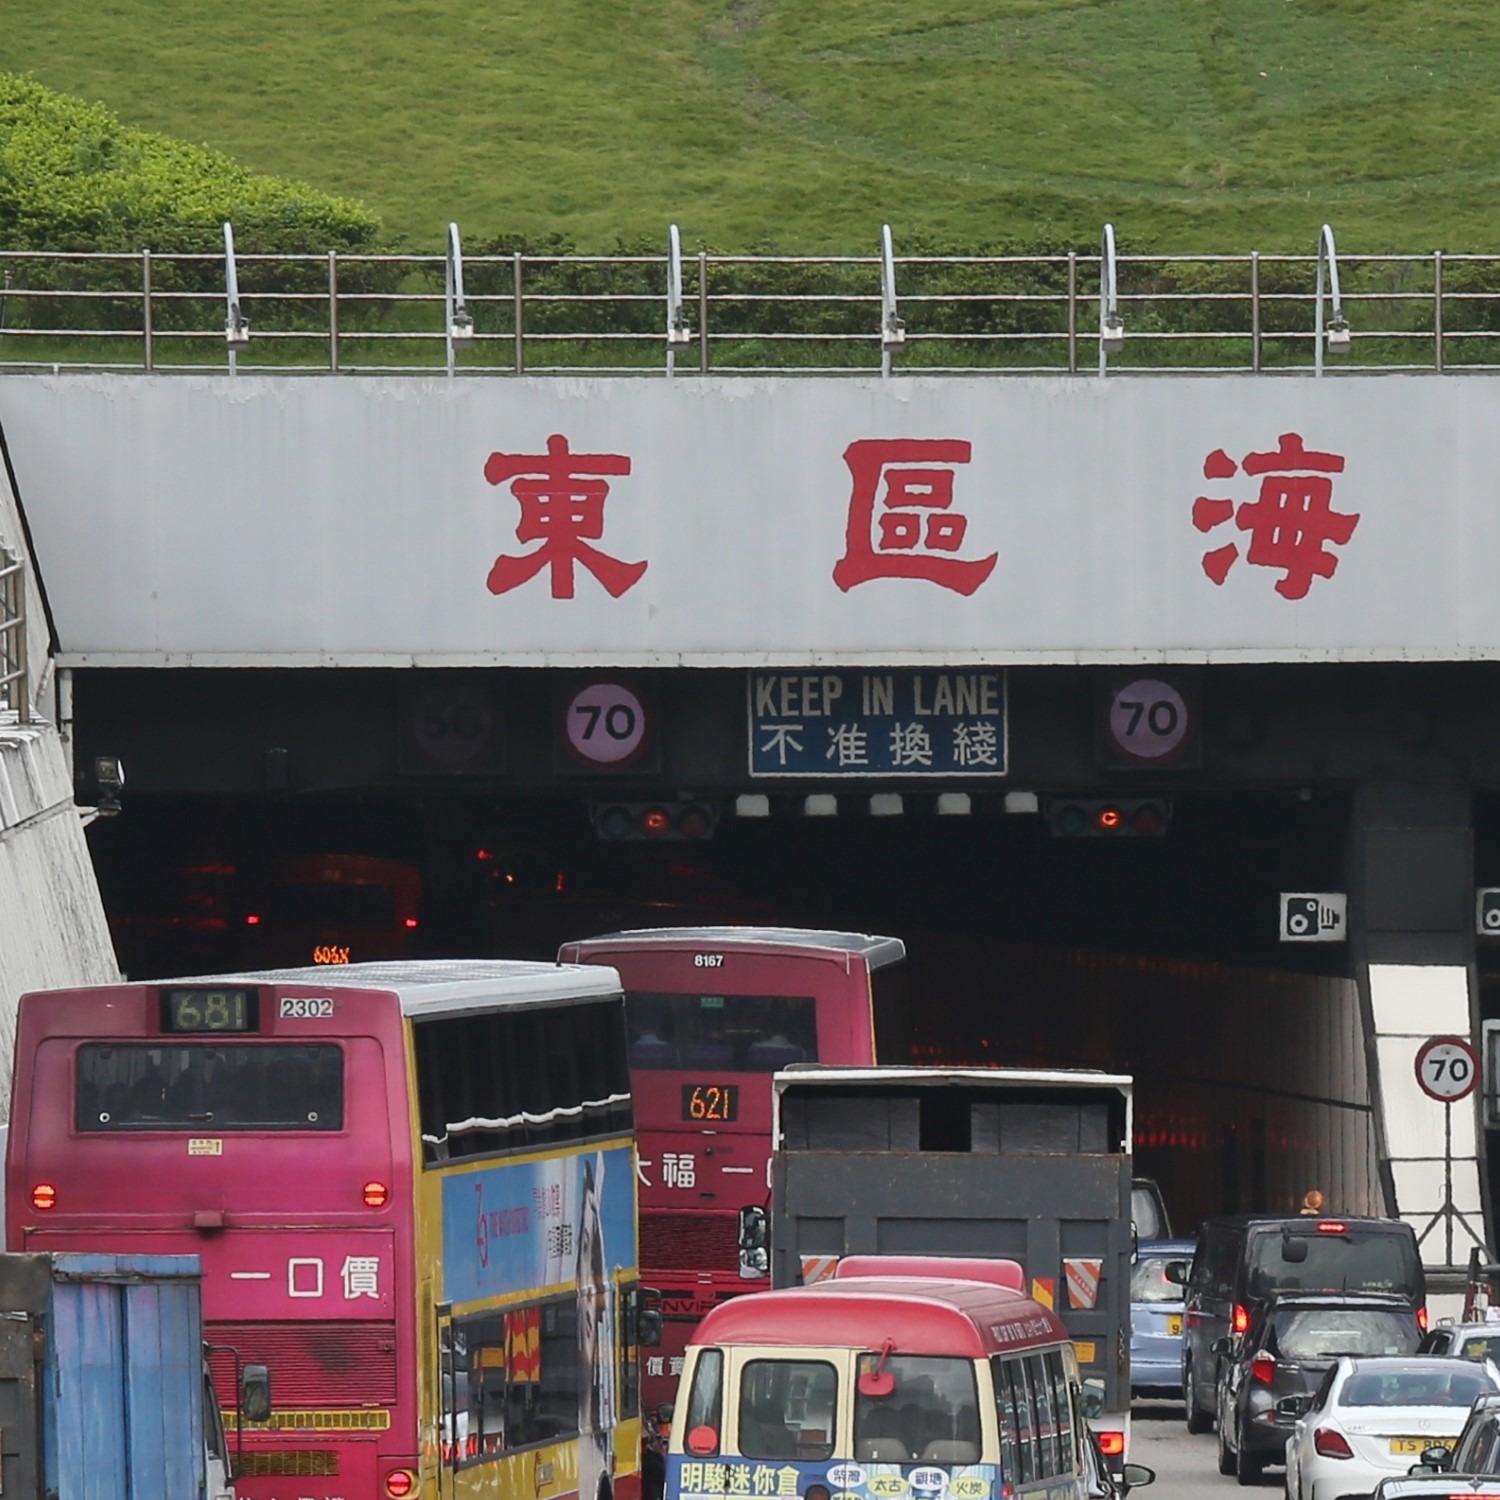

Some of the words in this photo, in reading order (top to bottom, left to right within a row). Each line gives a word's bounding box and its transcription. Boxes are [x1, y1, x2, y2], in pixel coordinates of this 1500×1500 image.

[757, 676, 835, 717] KEEP
[863, 675, 894, 716] IN
[913, 673, 999, 716] LANE
[575, 703, 636, 741] 70
[1119, 701, 1179, 737] 70
[694, 954, 724, 968] 8167
[176, 992, 243, 1029] 681
[282, 999, 333, 1018] 2302
[1429, 1057, 1469, 1083] 70
[689, 1086, 729, 1120] 621
[230, 1255, 381, 1300] 一口價
[1399, 1439, 1417, 1451] TS
[680, 1462, 800, 1496] 明駿迷你倉
[874, 1479, 902, 1492] 太古
[956, 1481, 983, 1495] 火炭
